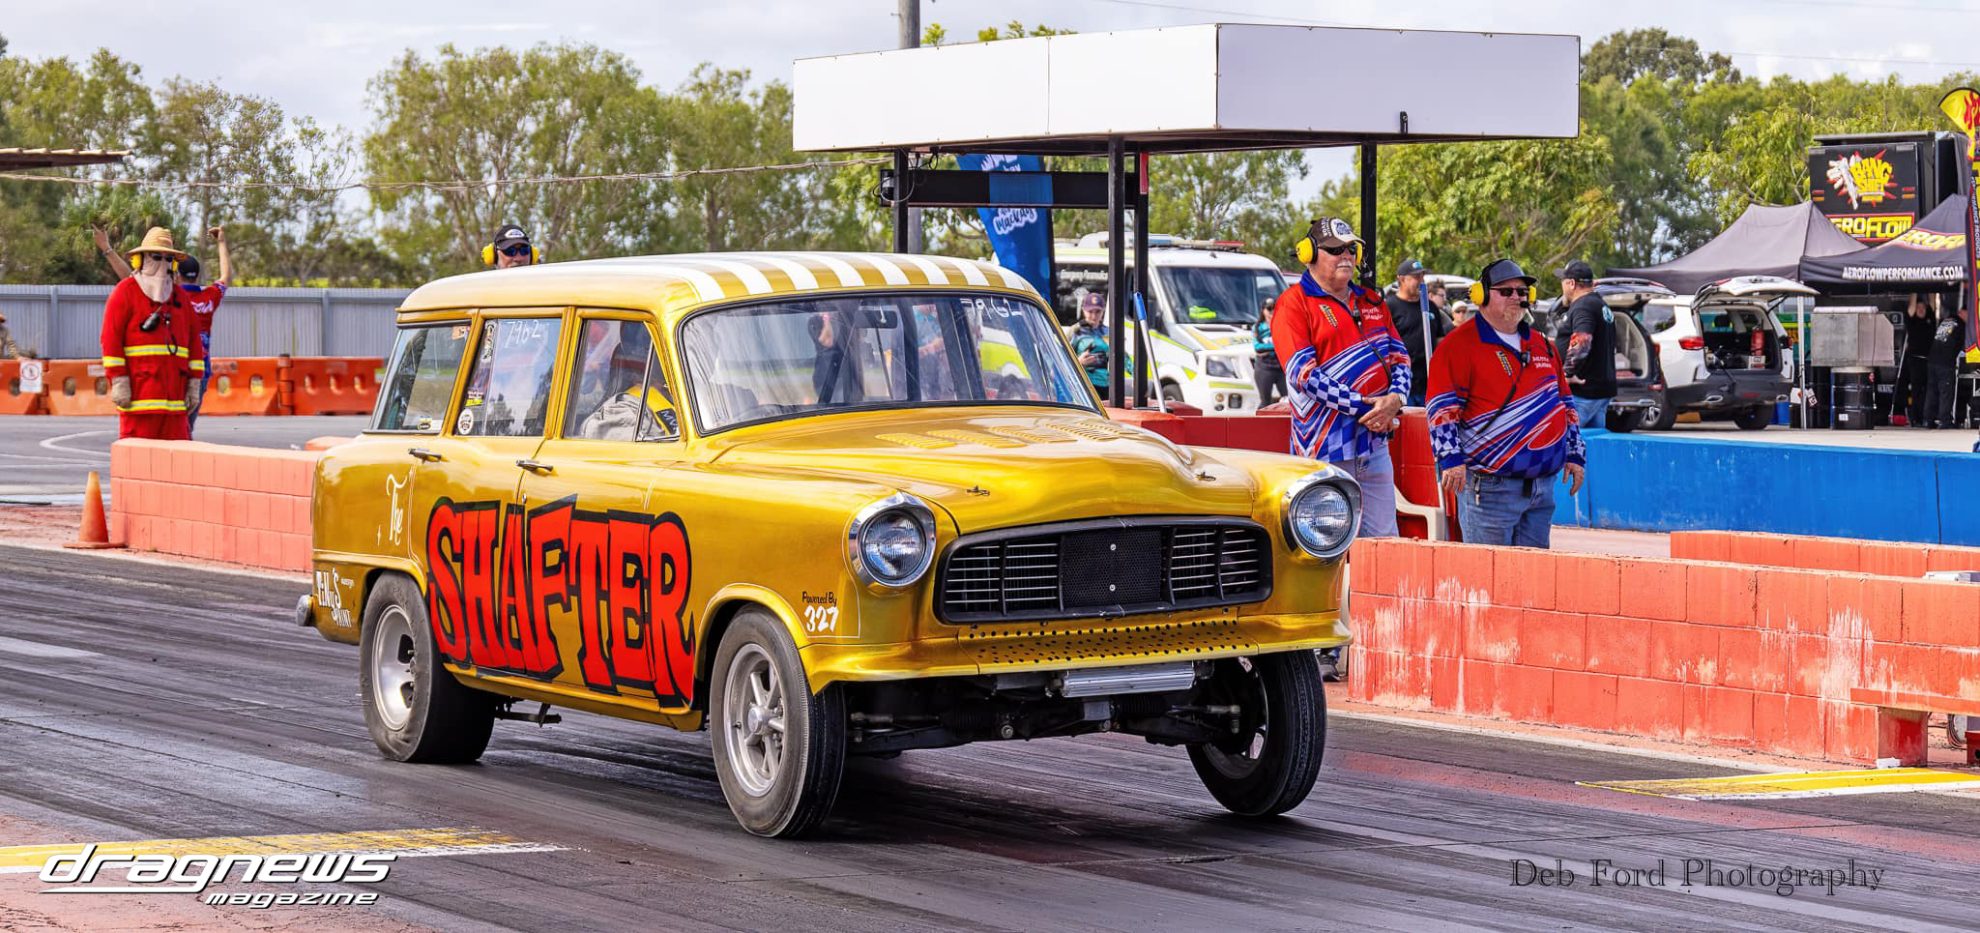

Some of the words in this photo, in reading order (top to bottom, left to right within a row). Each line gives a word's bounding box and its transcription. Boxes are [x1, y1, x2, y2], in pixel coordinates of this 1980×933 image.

[1842, 266, 1964, 280] AEROFLOWPERFORMANCE.COM
[386, 473, 408, 546] The
[425, 493, 696, 709] SHAFTER
[802, 591, 828, 604] Powered
[829, 591, 837, 608] By
[804, 605, 840, 632] 327
